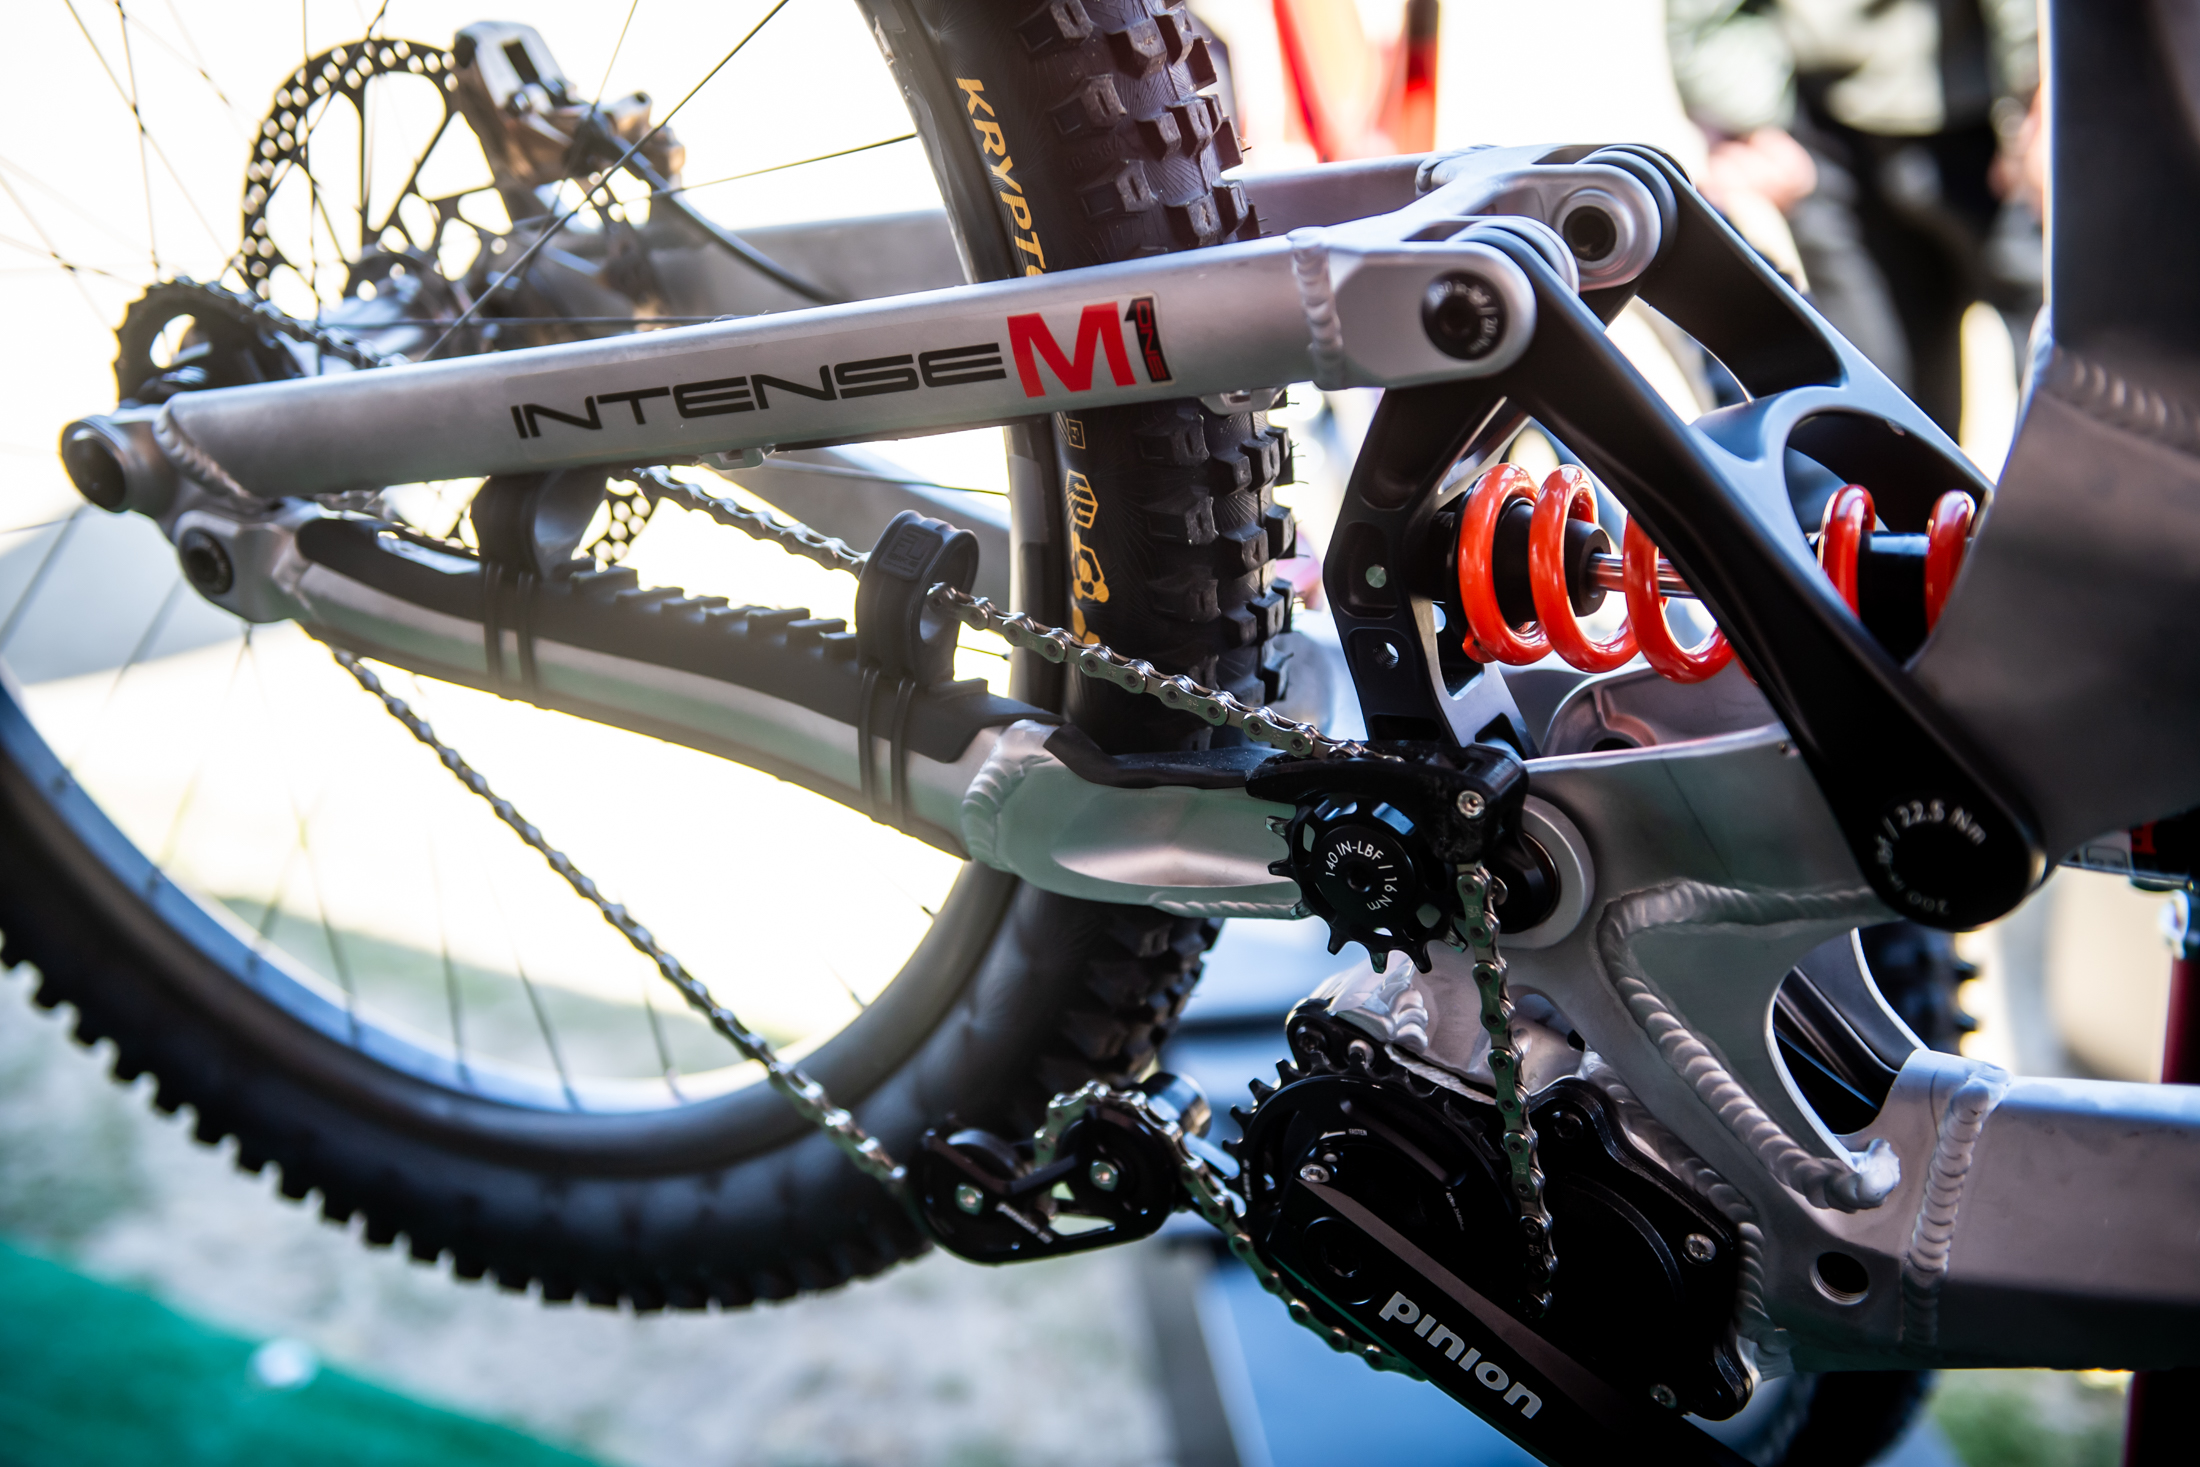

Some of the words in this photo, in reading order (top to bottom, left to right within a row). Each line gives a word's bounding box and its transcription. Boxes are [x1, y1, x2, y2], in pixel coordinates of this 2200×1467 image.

[510, 342, 1007, 439] INTENSE
[1325, 851, 1339, 877] 140
[1335, 840, 1385, 861] IN-LBF
[1384, 876, 1398, 893] 16
[1378, 1290, 1543, 1419] pinion
